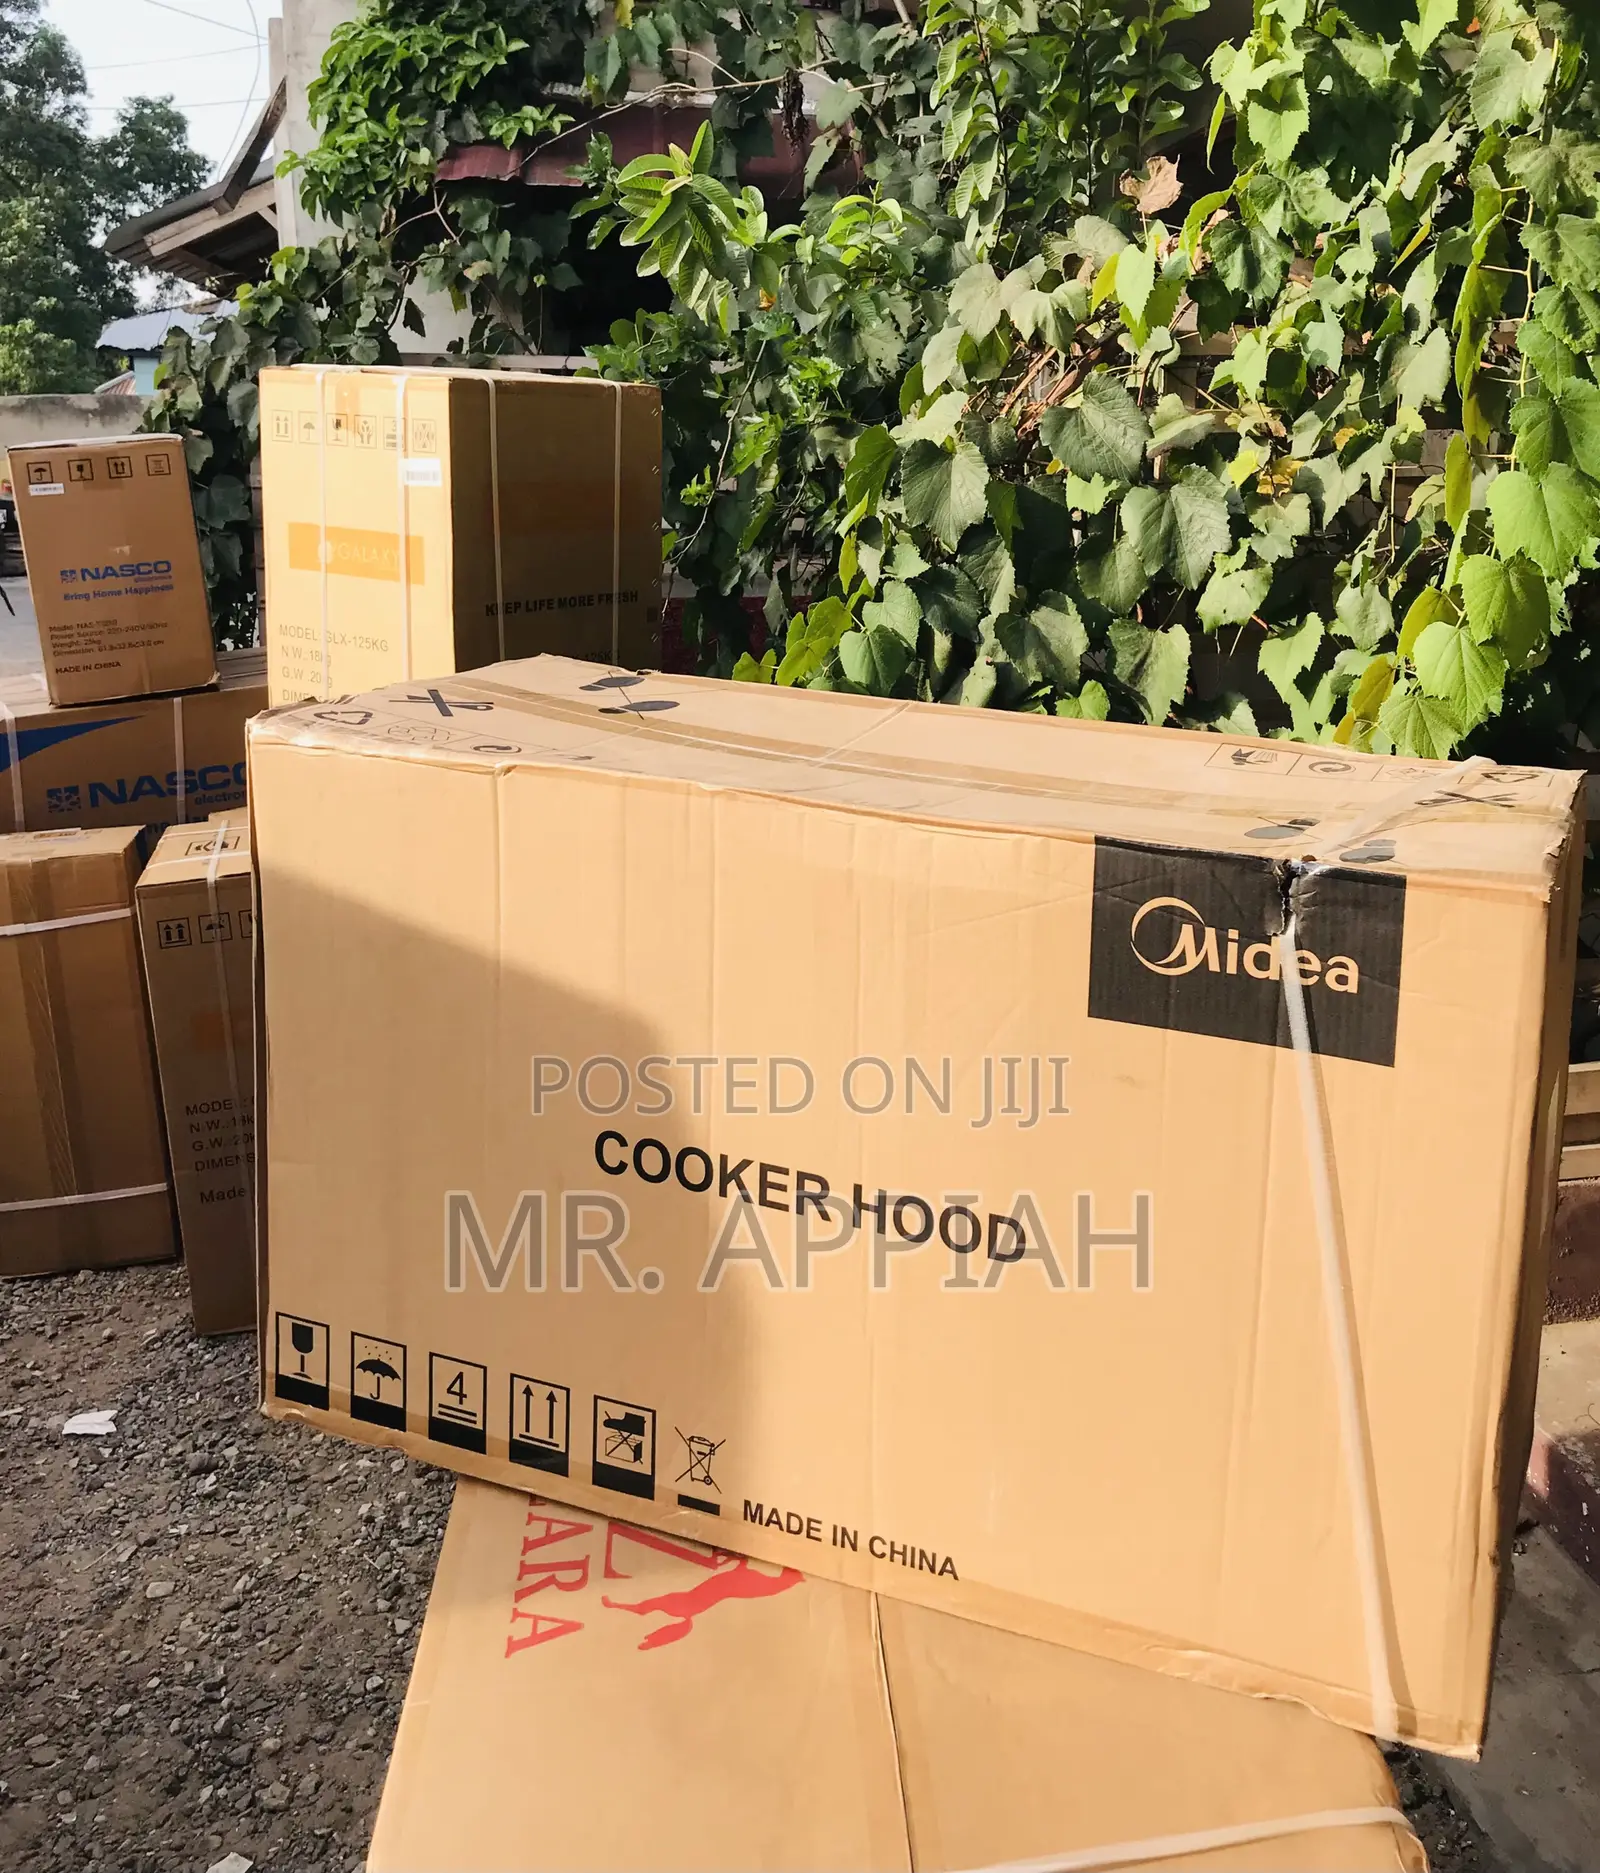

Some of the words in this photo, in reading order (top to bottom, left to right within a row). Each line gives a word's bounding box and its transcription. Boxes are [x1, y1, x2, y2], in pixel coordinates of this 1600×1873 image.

[81, 560, 171, 581] NASCO
[63, 593, 90, 602] Bring
[93, 589, 122, 599] Home
[125, 584, 174, 596] Happiness
[485, 602, 522, 616] KEP
[525, 598, 554, 612] LIFE
[557, 594, 594, 609] MORE
[56, 665, 81, 674] MADE
[83, 663, 92, 672] IN
[94, 661, 121, 671] CHINA
[1132, 899, 1360, 995] Midea
[200, 1185, 246, 1203] Made
[594, 1130, 832, 1221] COOKER
[852, 1183, 1027, 1264] HOOD
[446, 1371, 468, 1405] 4
[743, 1499, 823, 1542] MADE
[832, 1524, 859, 1552] IN
[868, 1535, 960, 1581] CHINA
